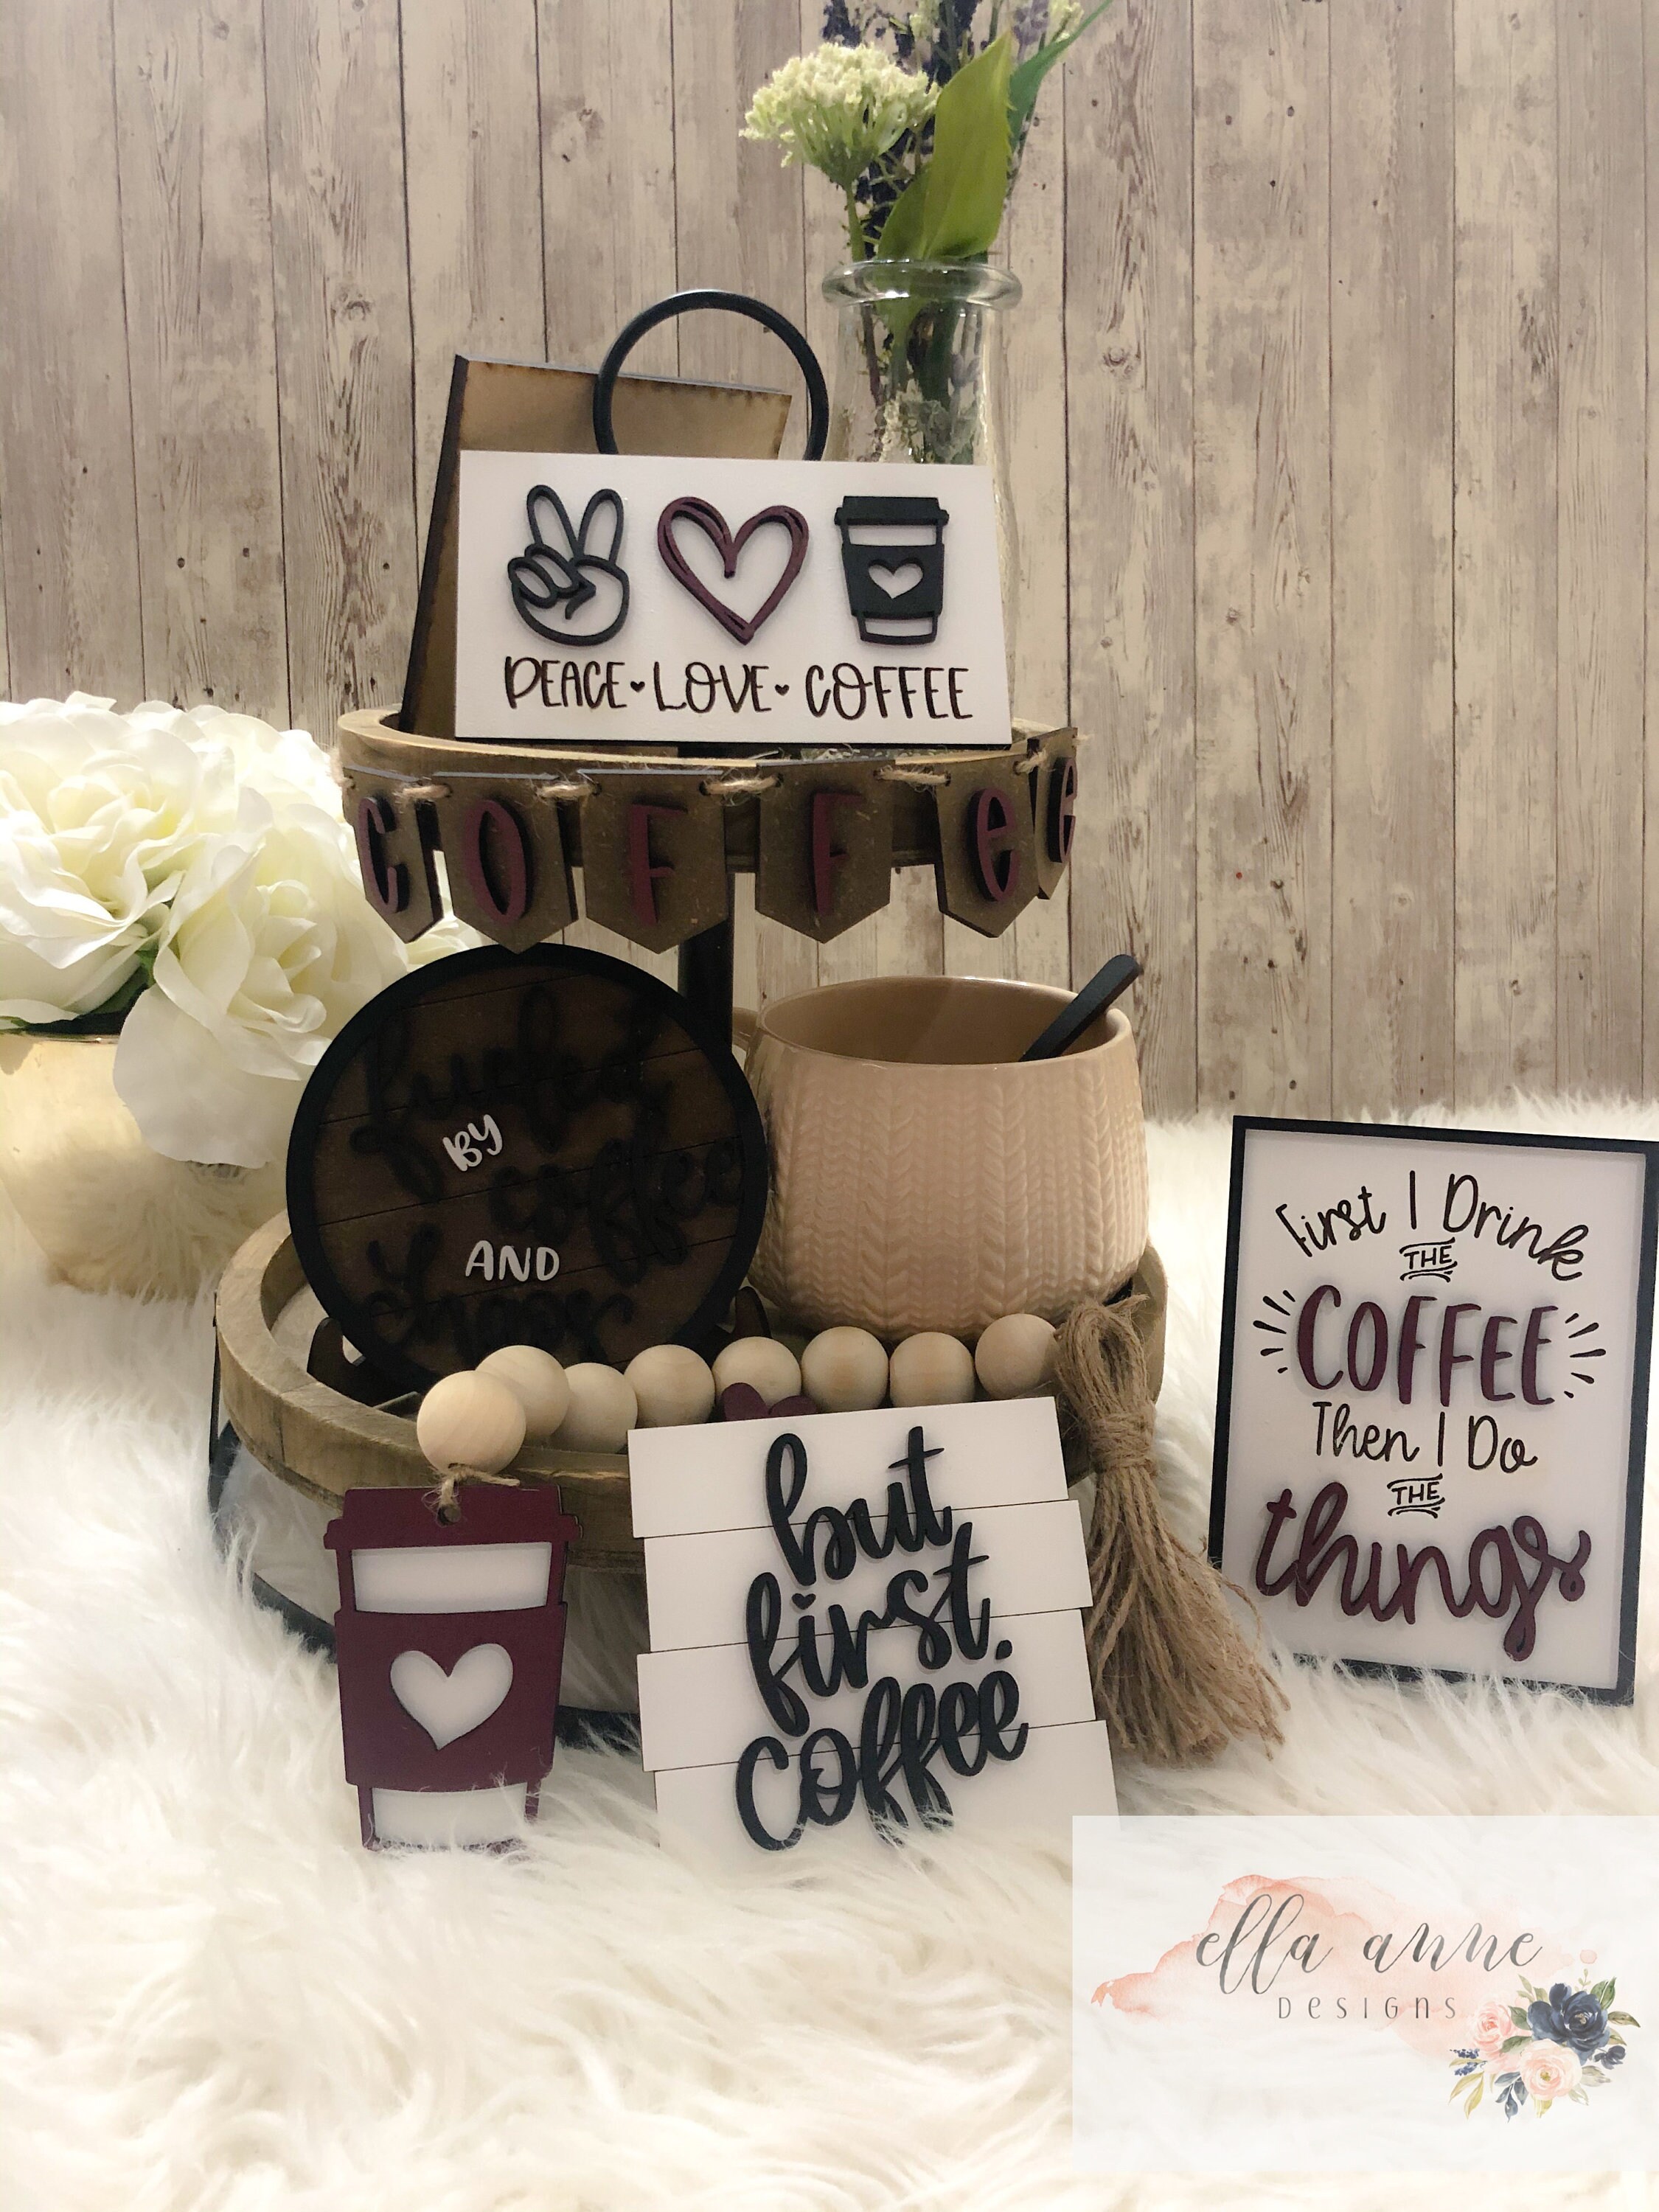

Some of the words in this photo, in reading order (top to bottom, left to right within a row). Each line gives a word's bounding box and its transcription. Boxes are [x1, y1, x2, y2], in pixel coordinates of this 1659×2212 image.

[504, 655, 626, 709] PEACE
[653, 661, 771, 714] LOVE
[806, 661, 973, 720] COFFEE
[442, 1114, 503, 1171] BY
[465, 1239, 560, 1281] AND
[1276, 1186, 1386, 1257] First
[1409, 1170, 1418, 1230] I
[1442, 1173, 1589, 1281] Drink
[1404, 1245, 1453, 1267] THE
[1296, 1284, 1559, 1408] COFFEE
[1312, 1401, 1420, 1462] Then
[1437, 1411, 1446, 1467] I
[1468, 1415, 1539, 1473] Do
[765, 1426, 953, 1586] but
[1391, 1481, 1441, 1505] THE
[1255, 1481, 1592, 1661] things
[736, 1670, 1029, 1852] coffee
